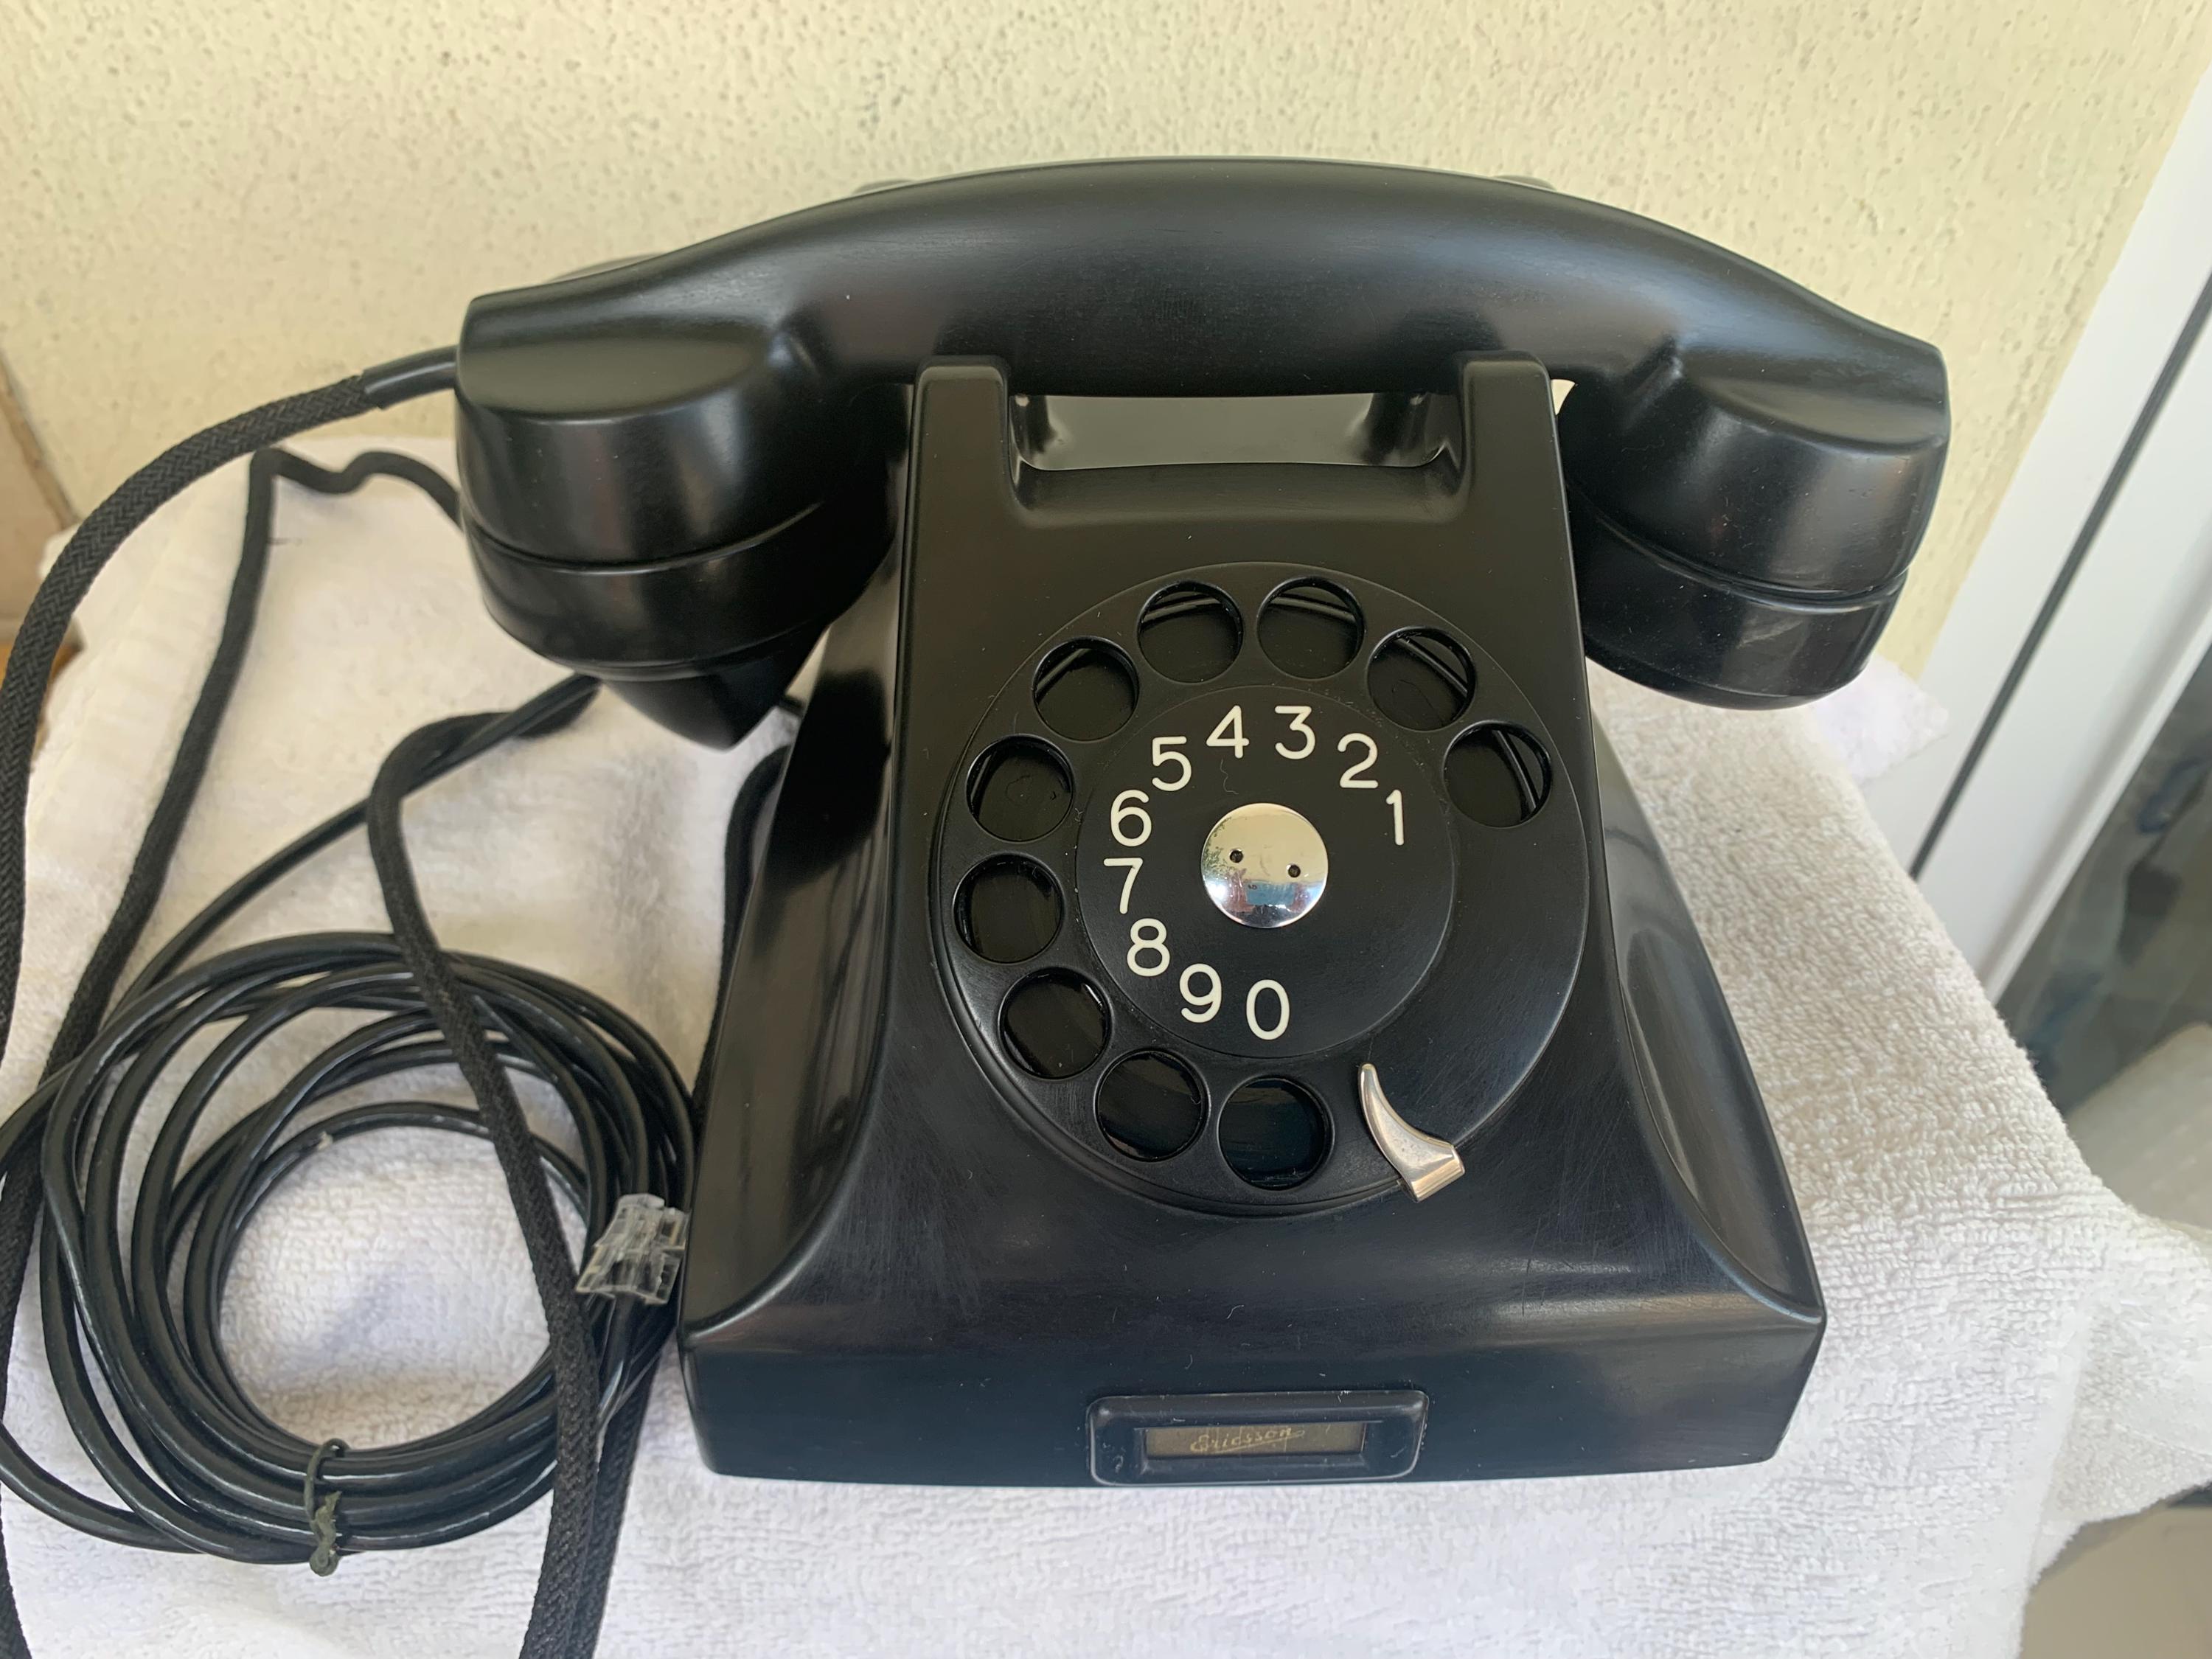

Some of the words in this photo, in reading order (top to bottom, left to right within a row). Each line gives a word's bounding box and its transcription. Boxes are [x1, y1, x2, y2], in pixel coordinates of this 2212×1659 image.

[1206, 706, 1249, 758] 4
[1275, 706, 1315, 759] 3
[1152, 737, 1192, 791] 5
[1338, 733, 1378, 788] 2
[1111, 790, 1151, 846] 6
[1386, 790, 1404, 845] 1
[1104, 858, 1143, 914] 7
[1127, 919, 1169, 976] 8
[1180, 964, 1221, 1023] 9
[1247, 980, 1290, 1040] 0
[1189, 1427, 1302, 1453] Ericsson
